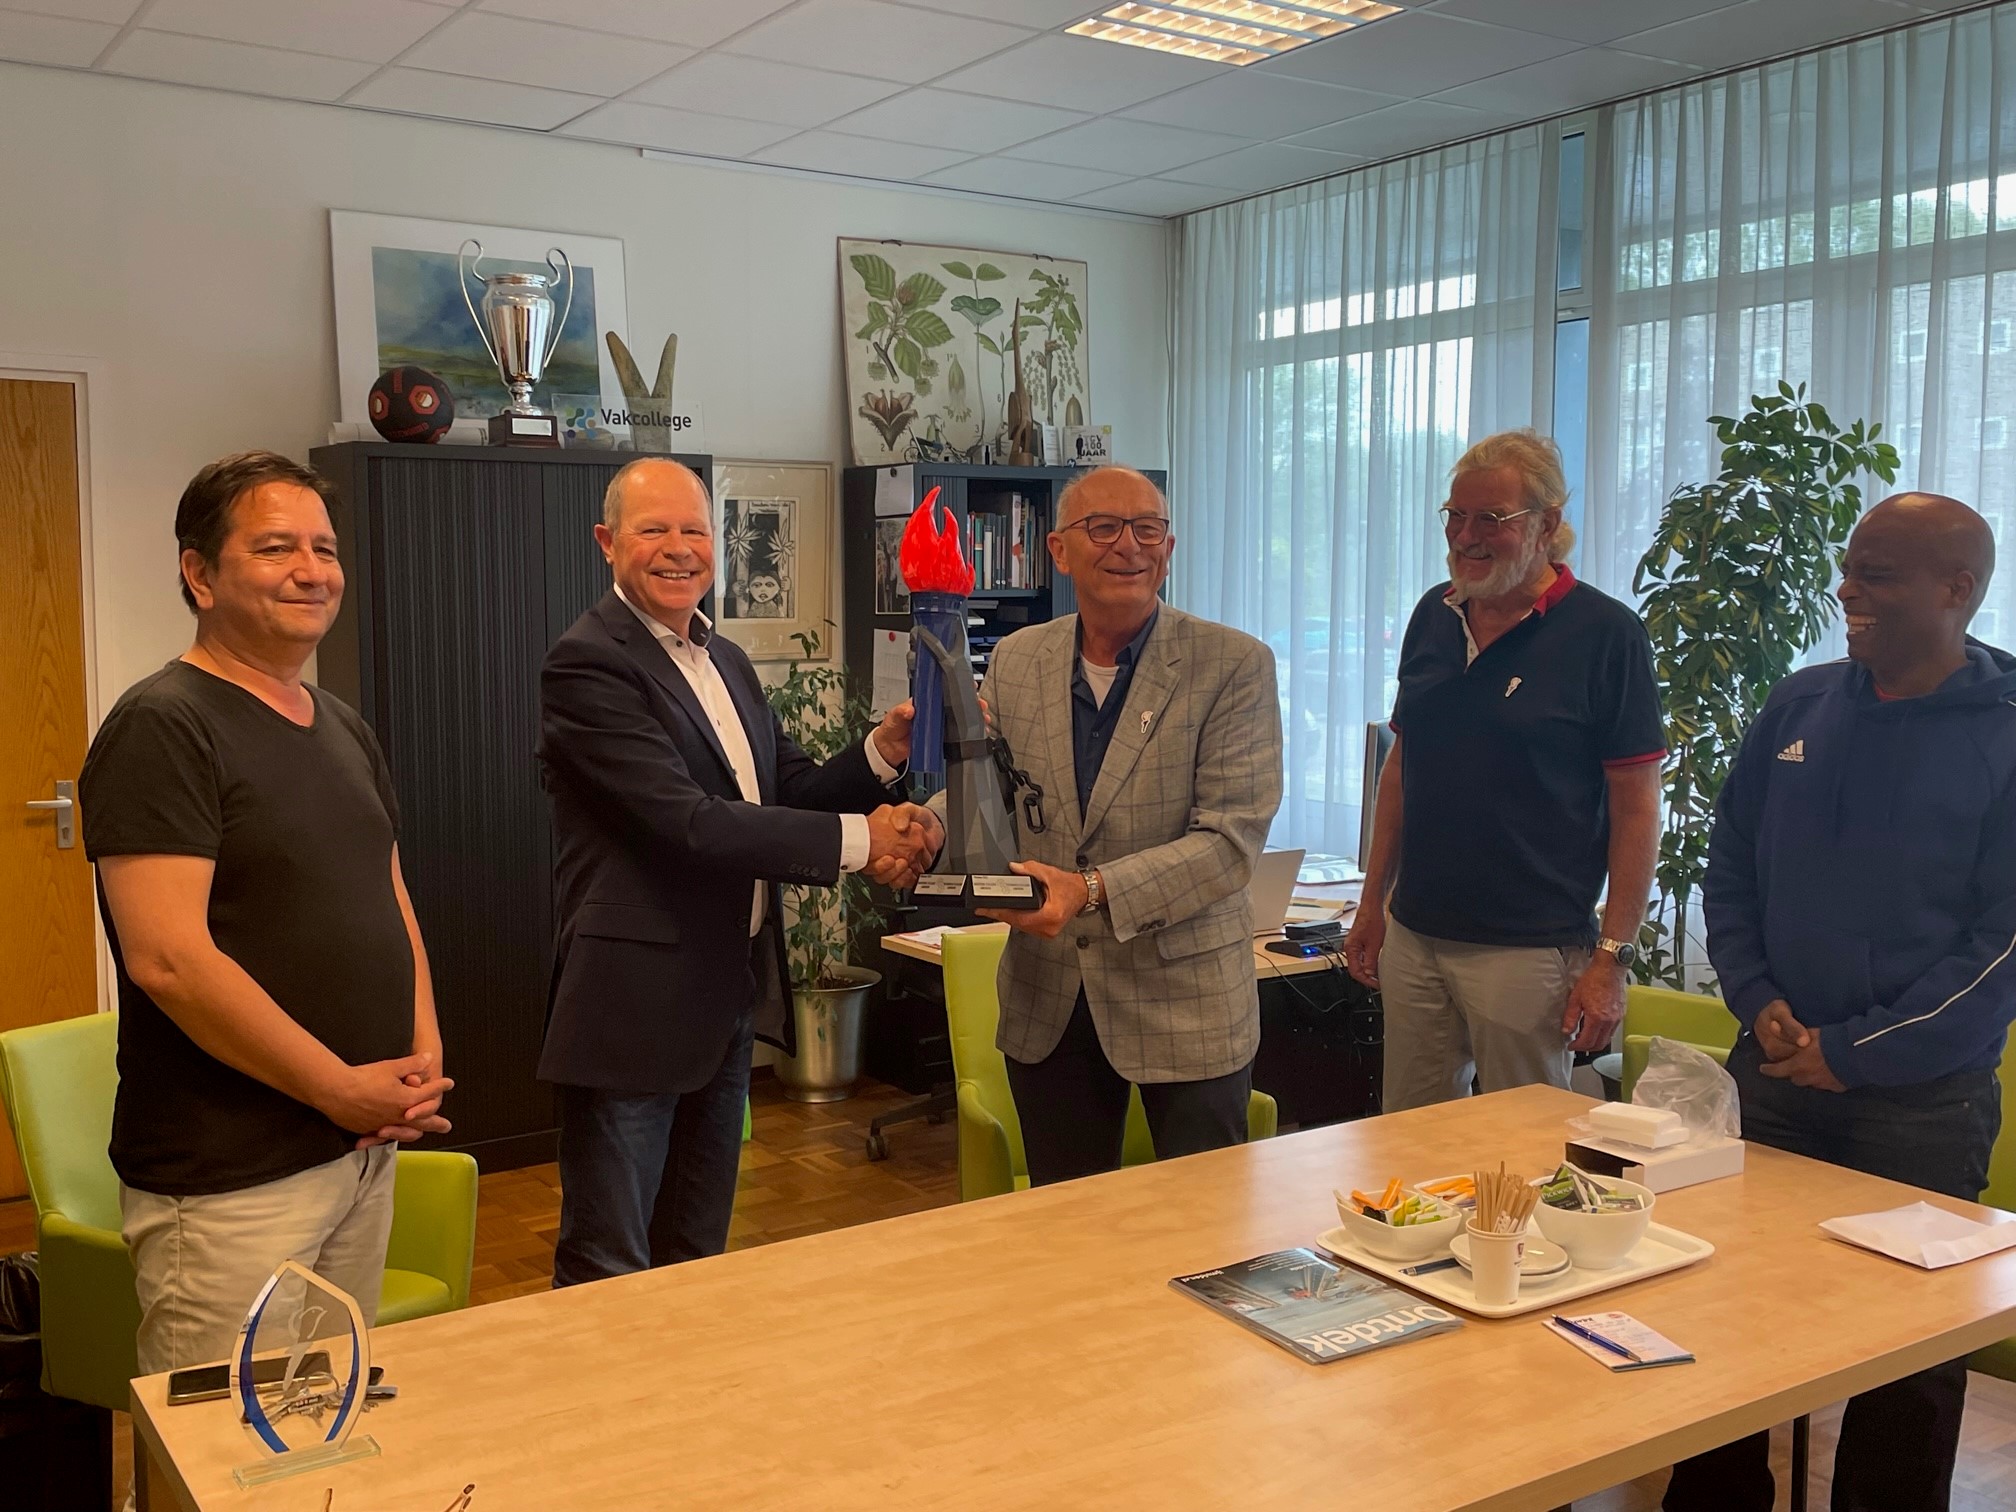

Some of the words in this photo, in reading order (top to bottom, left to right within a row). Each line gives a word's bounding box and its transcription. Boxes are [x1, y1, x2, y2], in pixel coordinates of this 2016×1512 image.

[601, 408, 692, 431] Vakcollege
[1081, 449, 1107, 457] JAAR
[1084, 441, 1102, 450] 100
[1299, 1304, 1457, 1354] Ontdek
